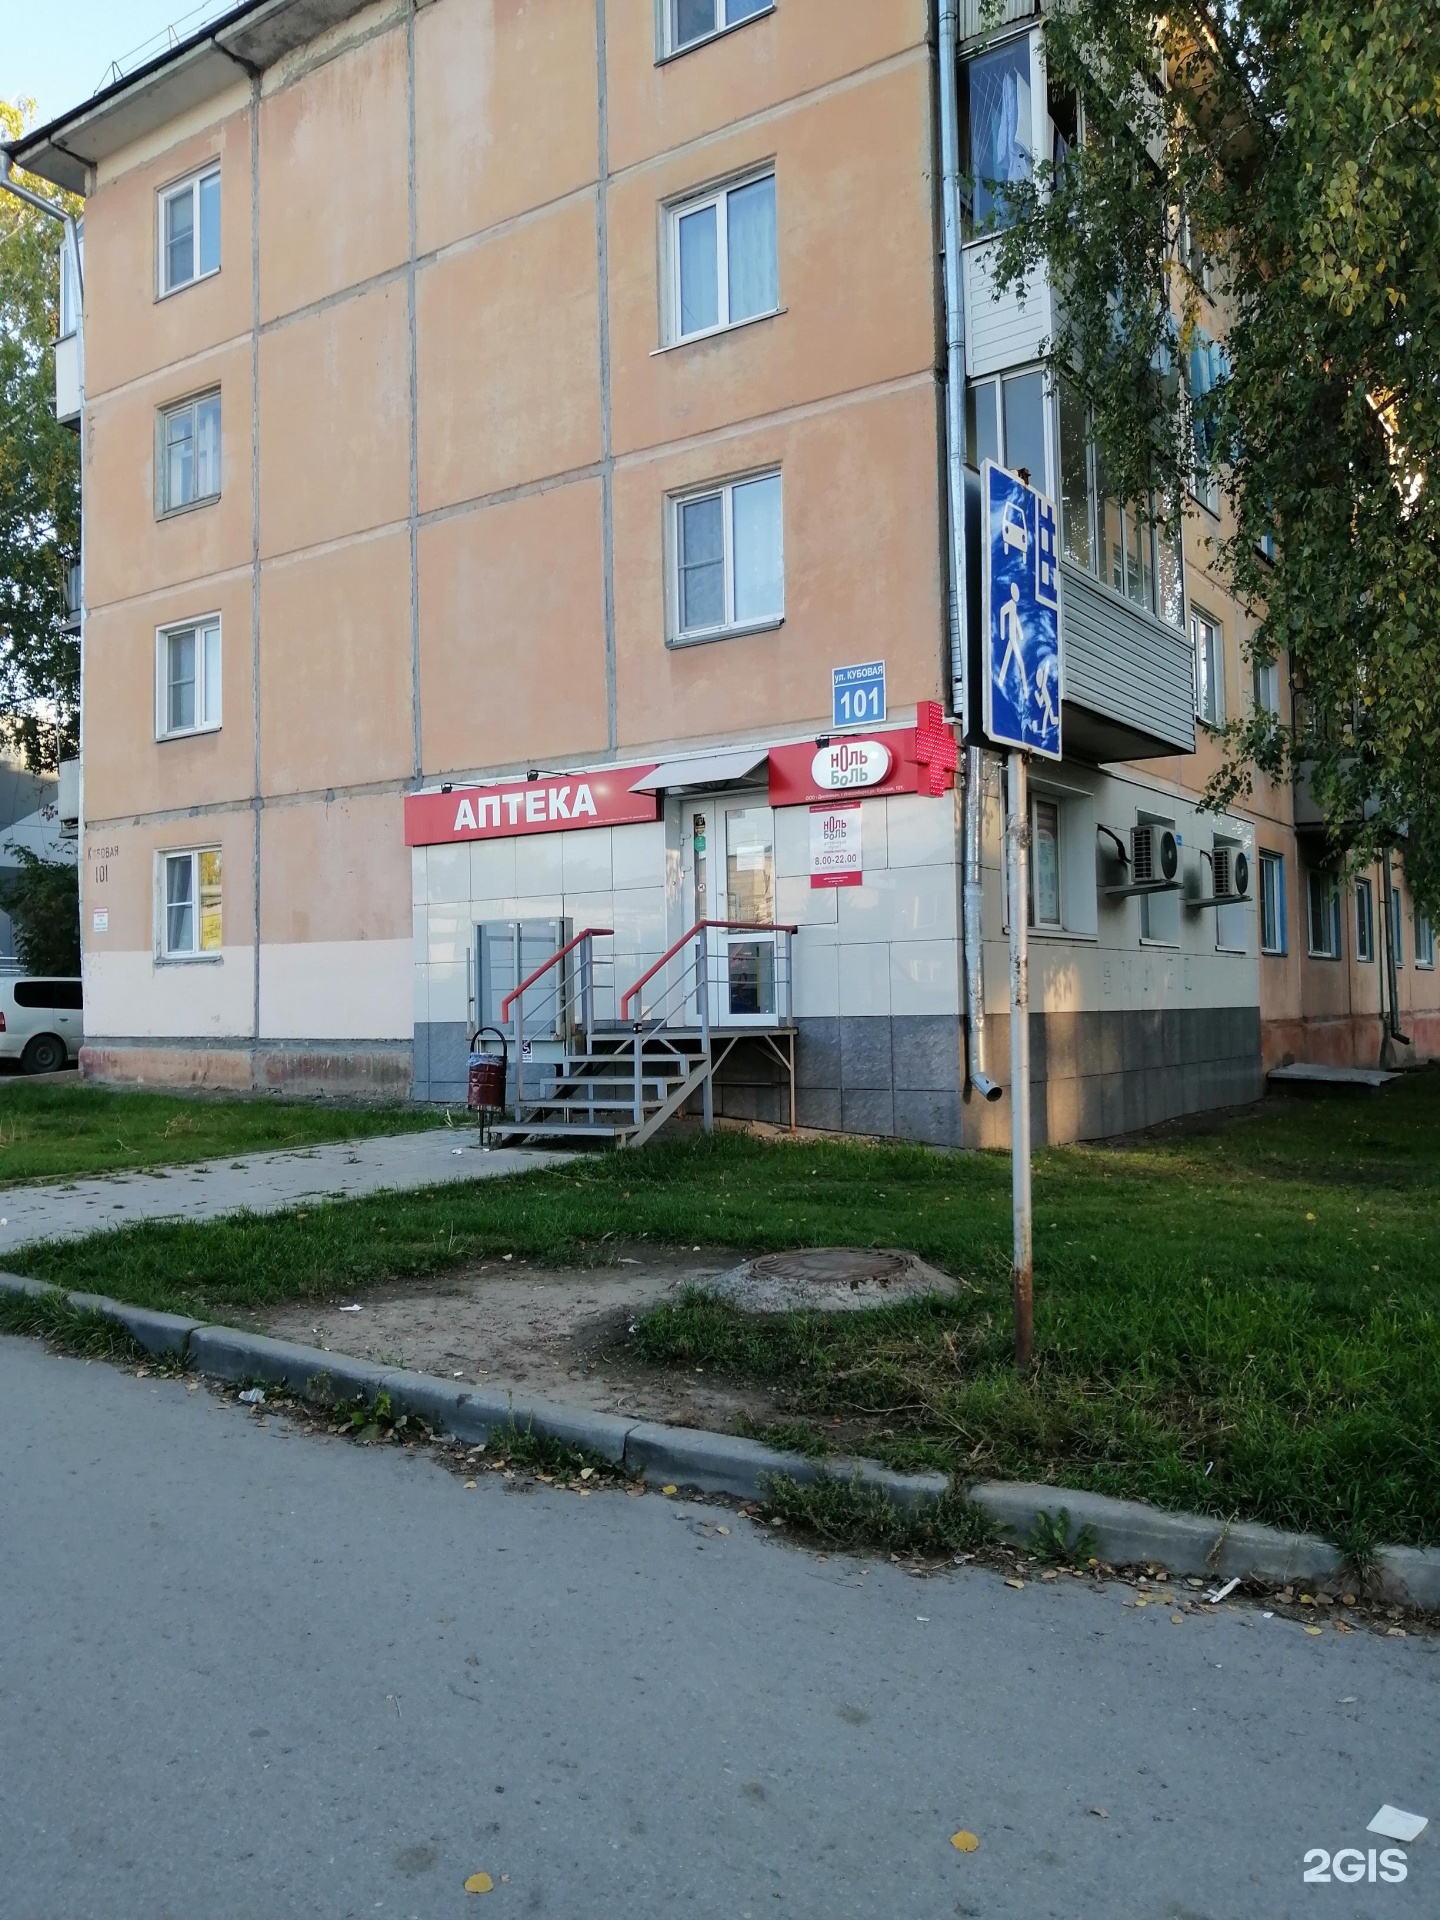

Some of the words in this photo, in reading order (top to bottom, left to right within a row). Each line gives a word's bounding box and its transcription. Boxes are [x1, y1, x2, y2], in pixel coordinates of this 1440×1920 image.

[834, 674, 846, 684] ул.
[847, 665, 883, 679] КУБОВАЯ
[840, 687, 879, 719] 101
[453, 784, 597, 831] АПТЕКА
[815, 854, 856, 865] 8.00-22.00
